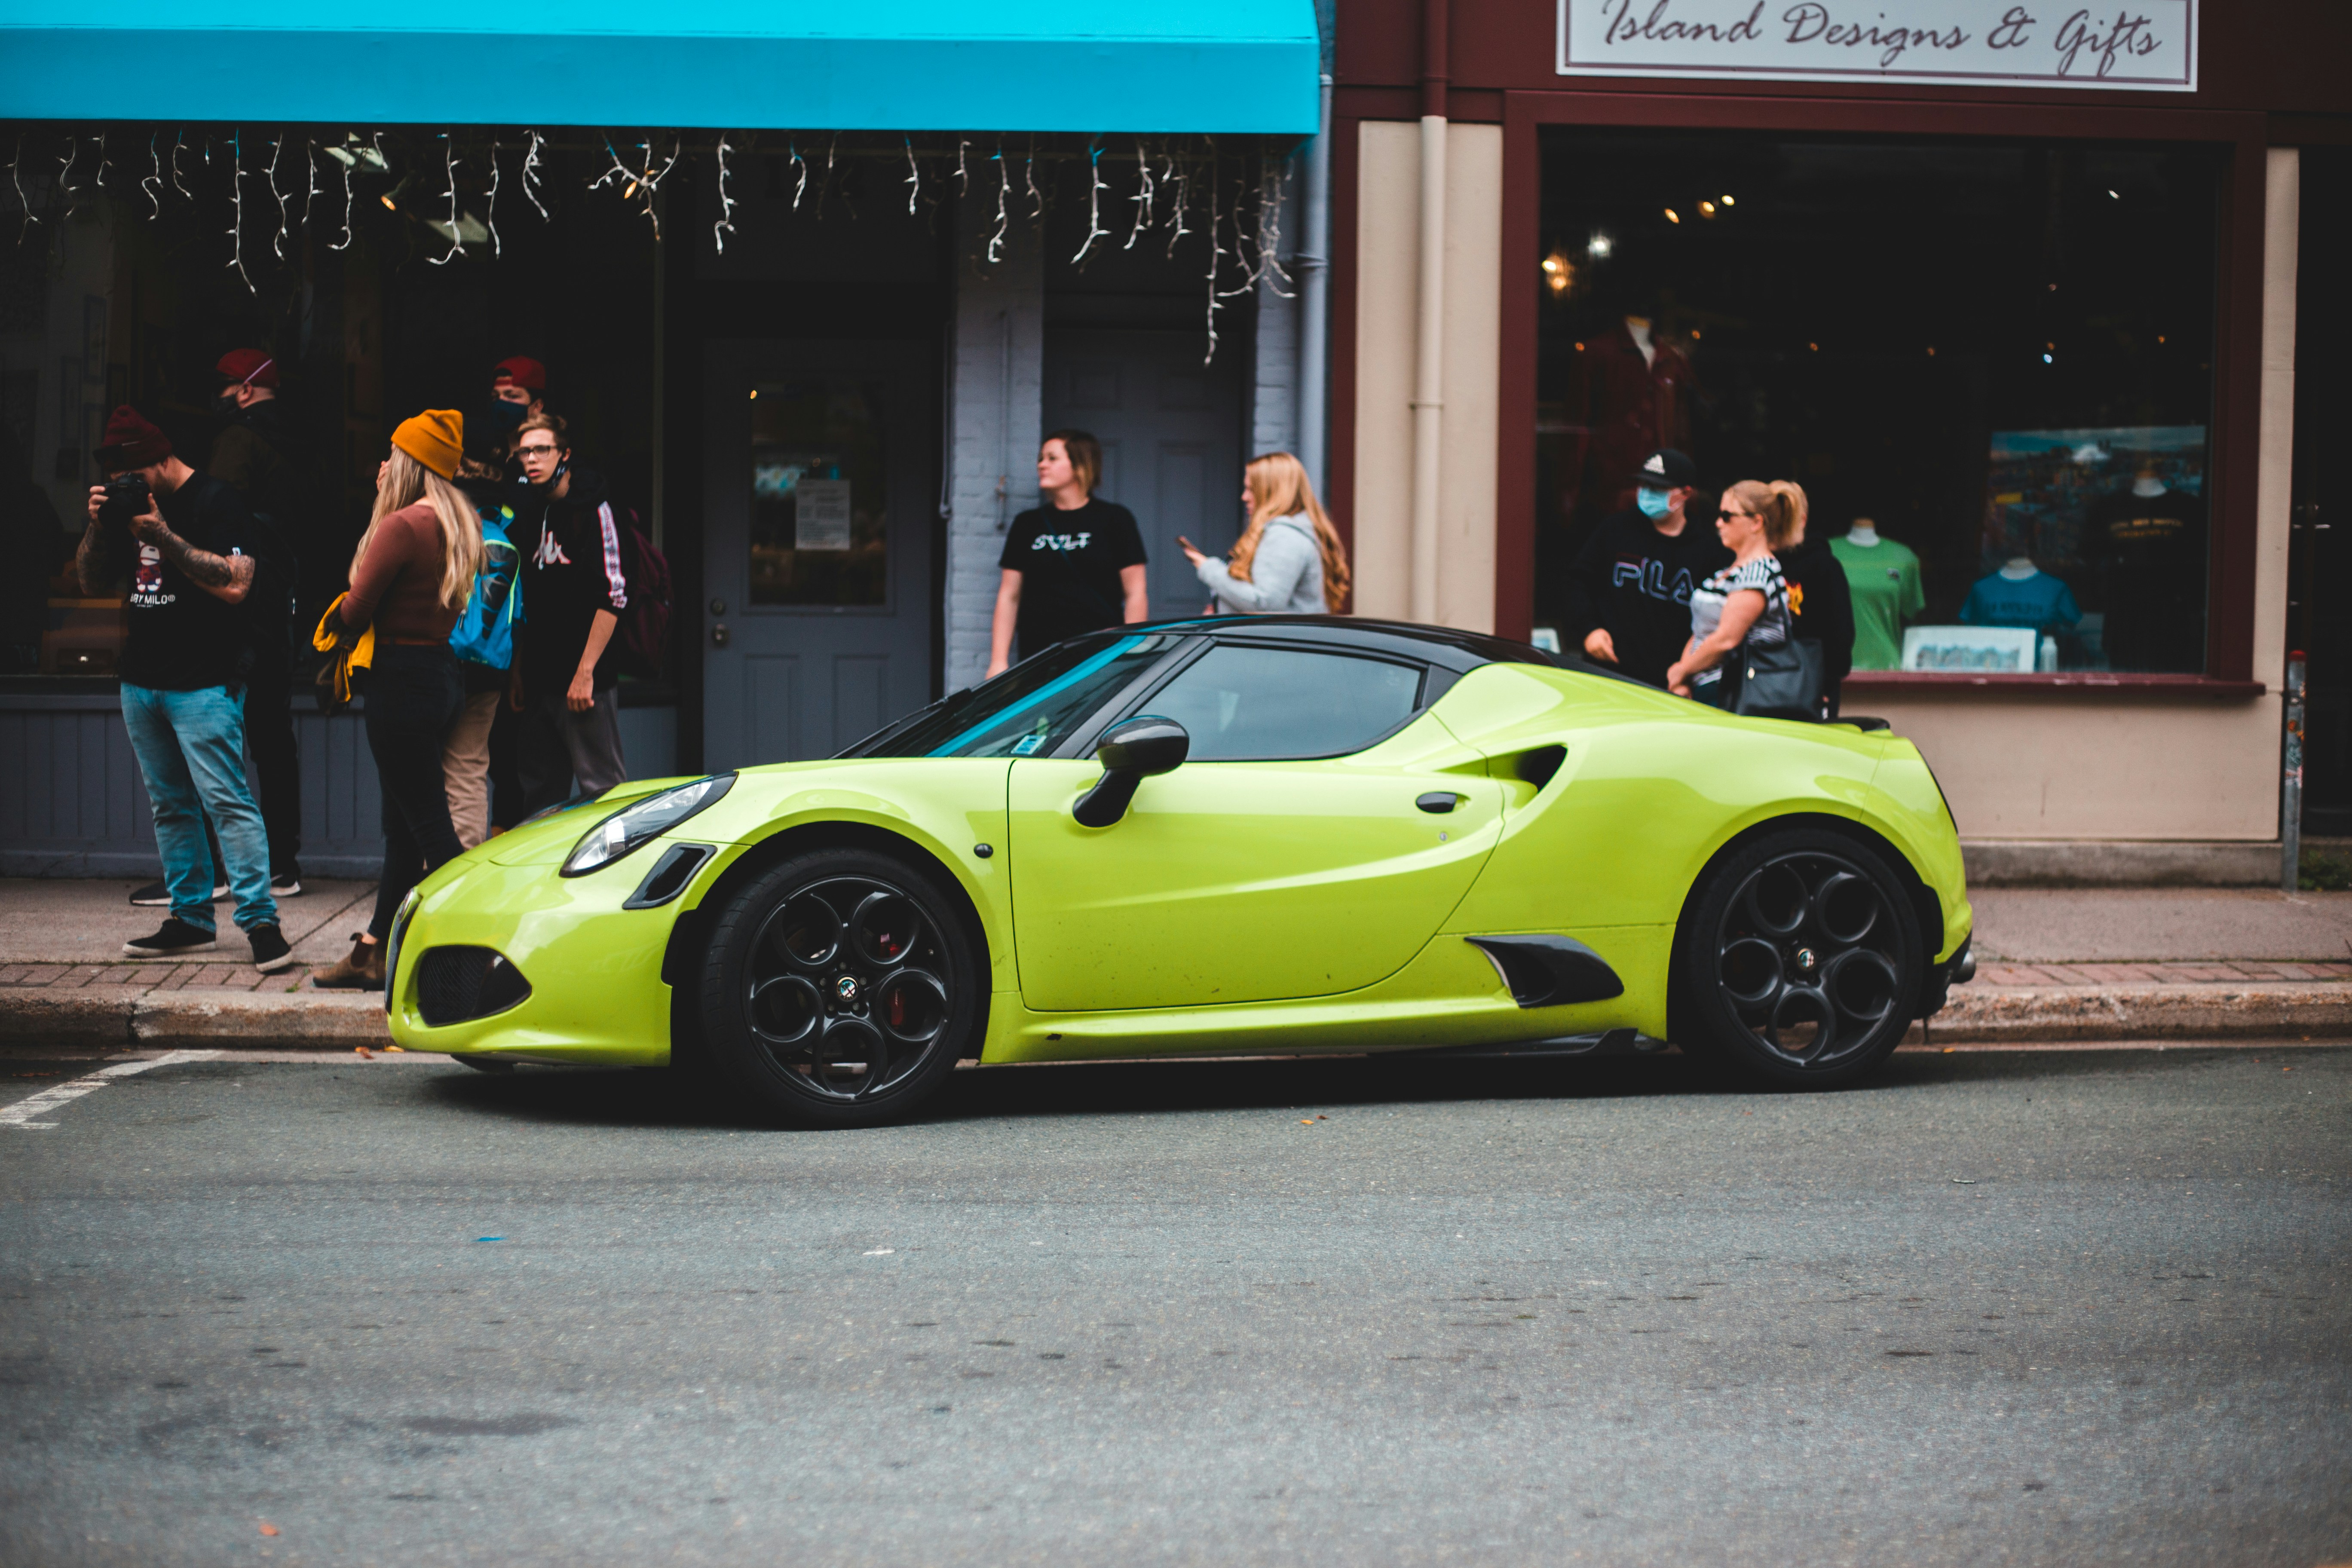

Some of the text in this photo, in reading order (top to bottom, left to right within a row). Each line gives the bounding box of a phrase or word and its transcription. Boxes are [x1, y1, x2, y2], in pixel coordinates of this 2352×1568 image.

[1602, 0, 2162, 77] Island Designs & Gifts
[1612, 552, 1694, 606] FILA
